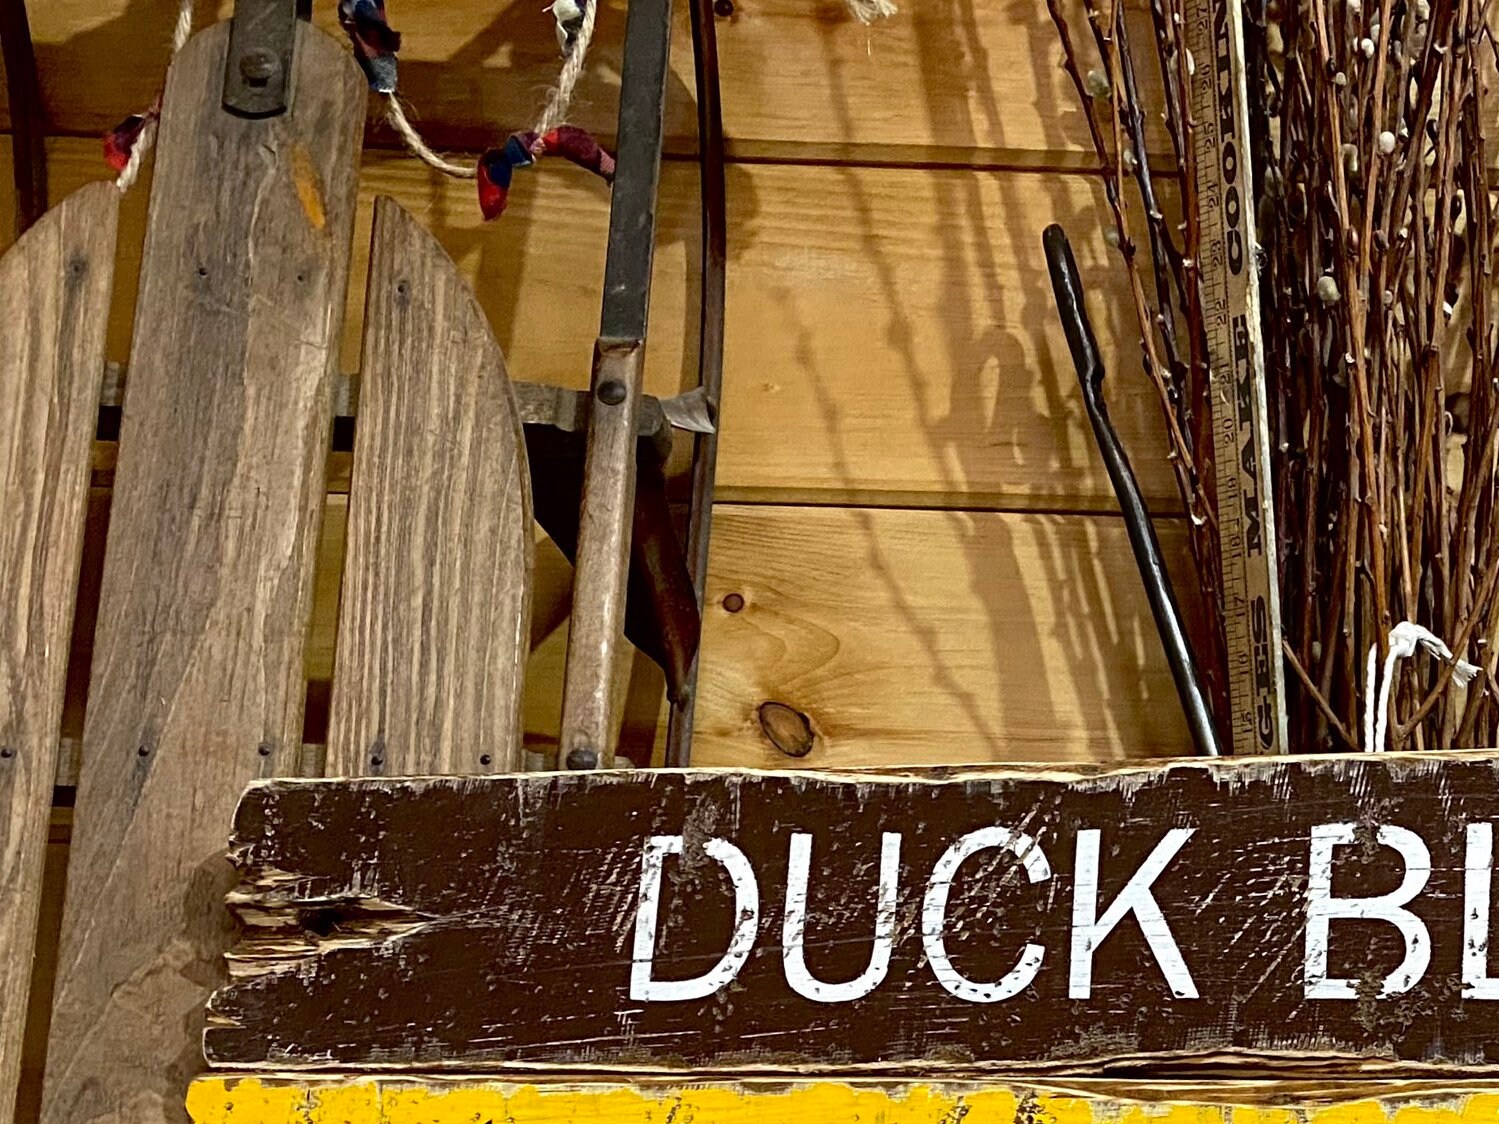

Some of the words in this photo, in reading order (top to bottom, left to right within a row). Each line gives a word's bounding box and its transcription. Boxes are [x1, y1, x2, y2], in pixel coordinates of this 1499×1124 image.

[1196, 7, 1208, 32] 27
[1200, 64, 1211, 91] 26
[1204, 122, 1215, 150] 25
[1207, 183, 1219, 209] 24
[1212, 240, 1223, 268] 23
[1216, 298, 1227, 327] 22
[1223, 417, 1235, 445] 20
[1232, 313, 1262, 559] MAKE
[1226, 477, 1238, 501] 19
[1230, 535, 1241, 560] 18
[1235, 596, 1246, 618] 17
[628, 825, 1200, 1002] DUCK
